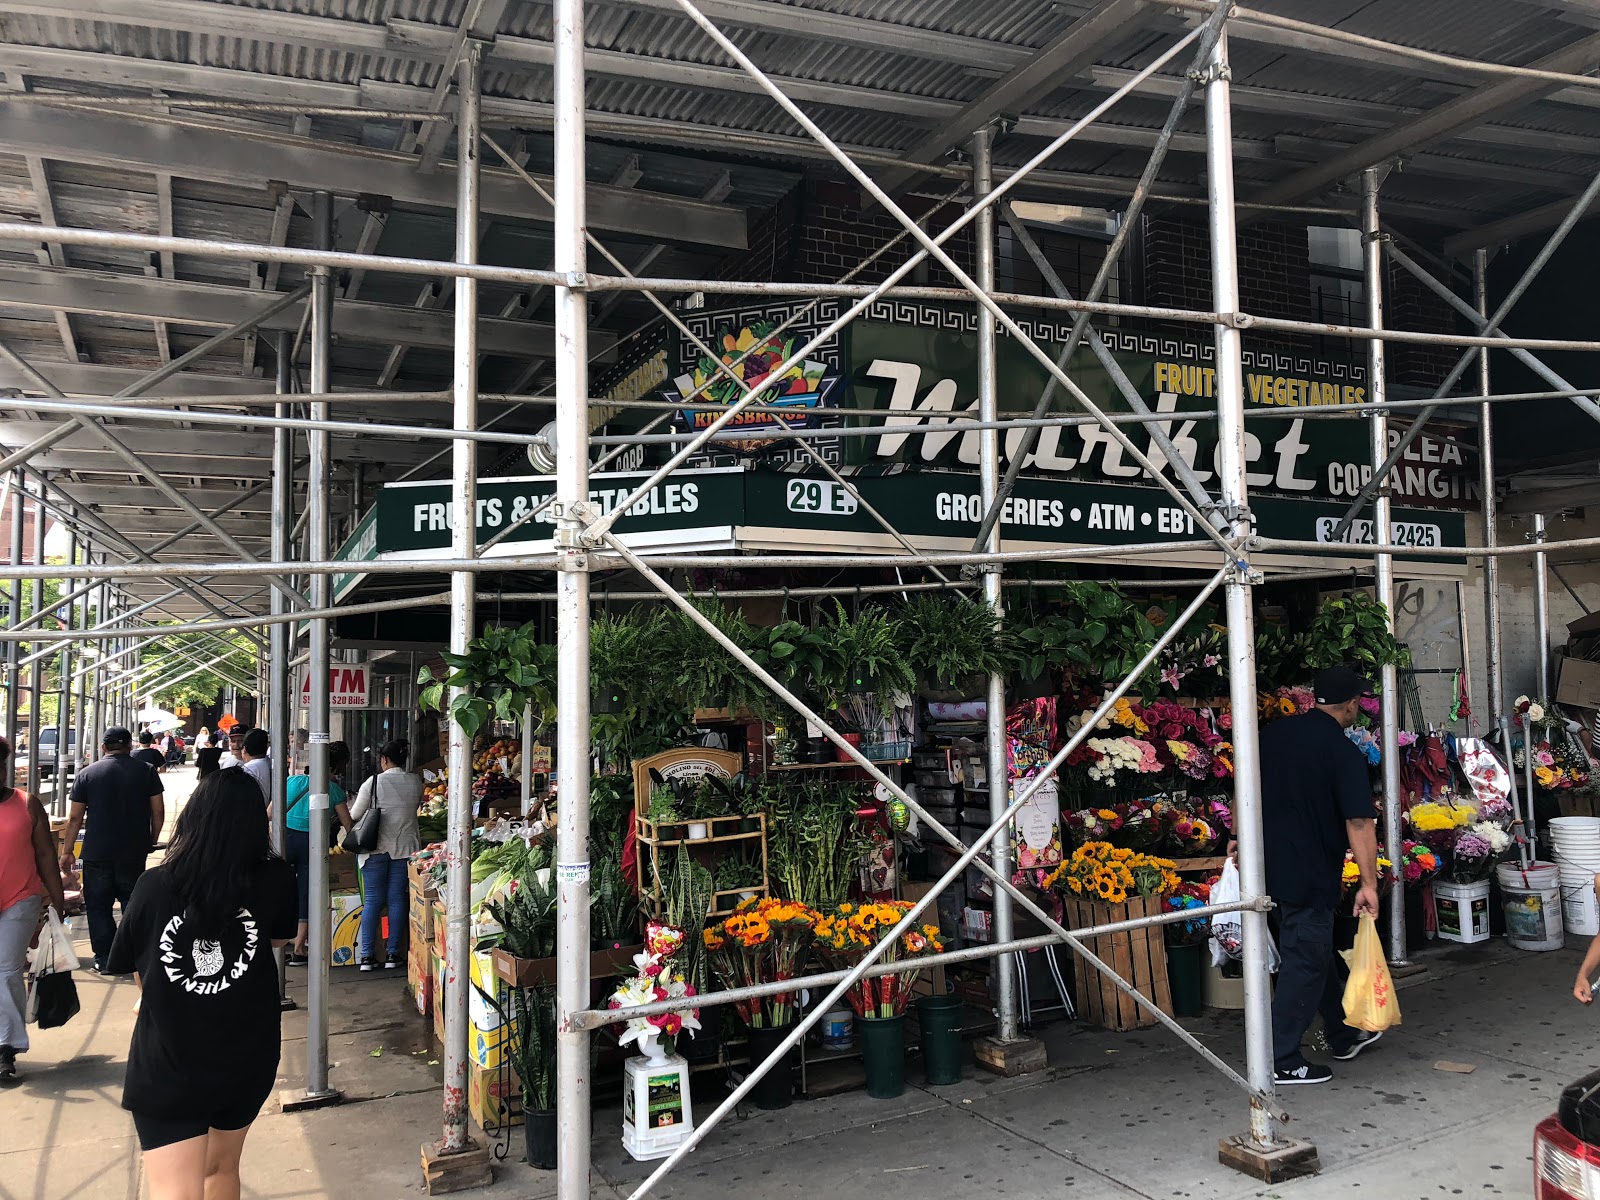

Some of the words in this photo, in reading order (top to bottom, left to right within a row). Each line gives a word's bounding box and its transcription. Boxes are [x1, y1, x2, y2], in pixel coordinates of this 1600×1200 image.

[718, 378, 781, 405] Nw
[1154, 361, 1218, 398] FRUIT
[414, 497, 503, 532] FRTS
[530, 482, 699, 525] VTABLES
[789, 482, 823, 511] 29
[936, 492, 1064, 528] GROERIES
[1087, 502, 1136, 531] ATM
[1157, 507, 1195, 535] EBT
[332, 695, 347, 705] $20
[348, 695, 365, 705] Bills
[180, 975, 231, 995] THEN
